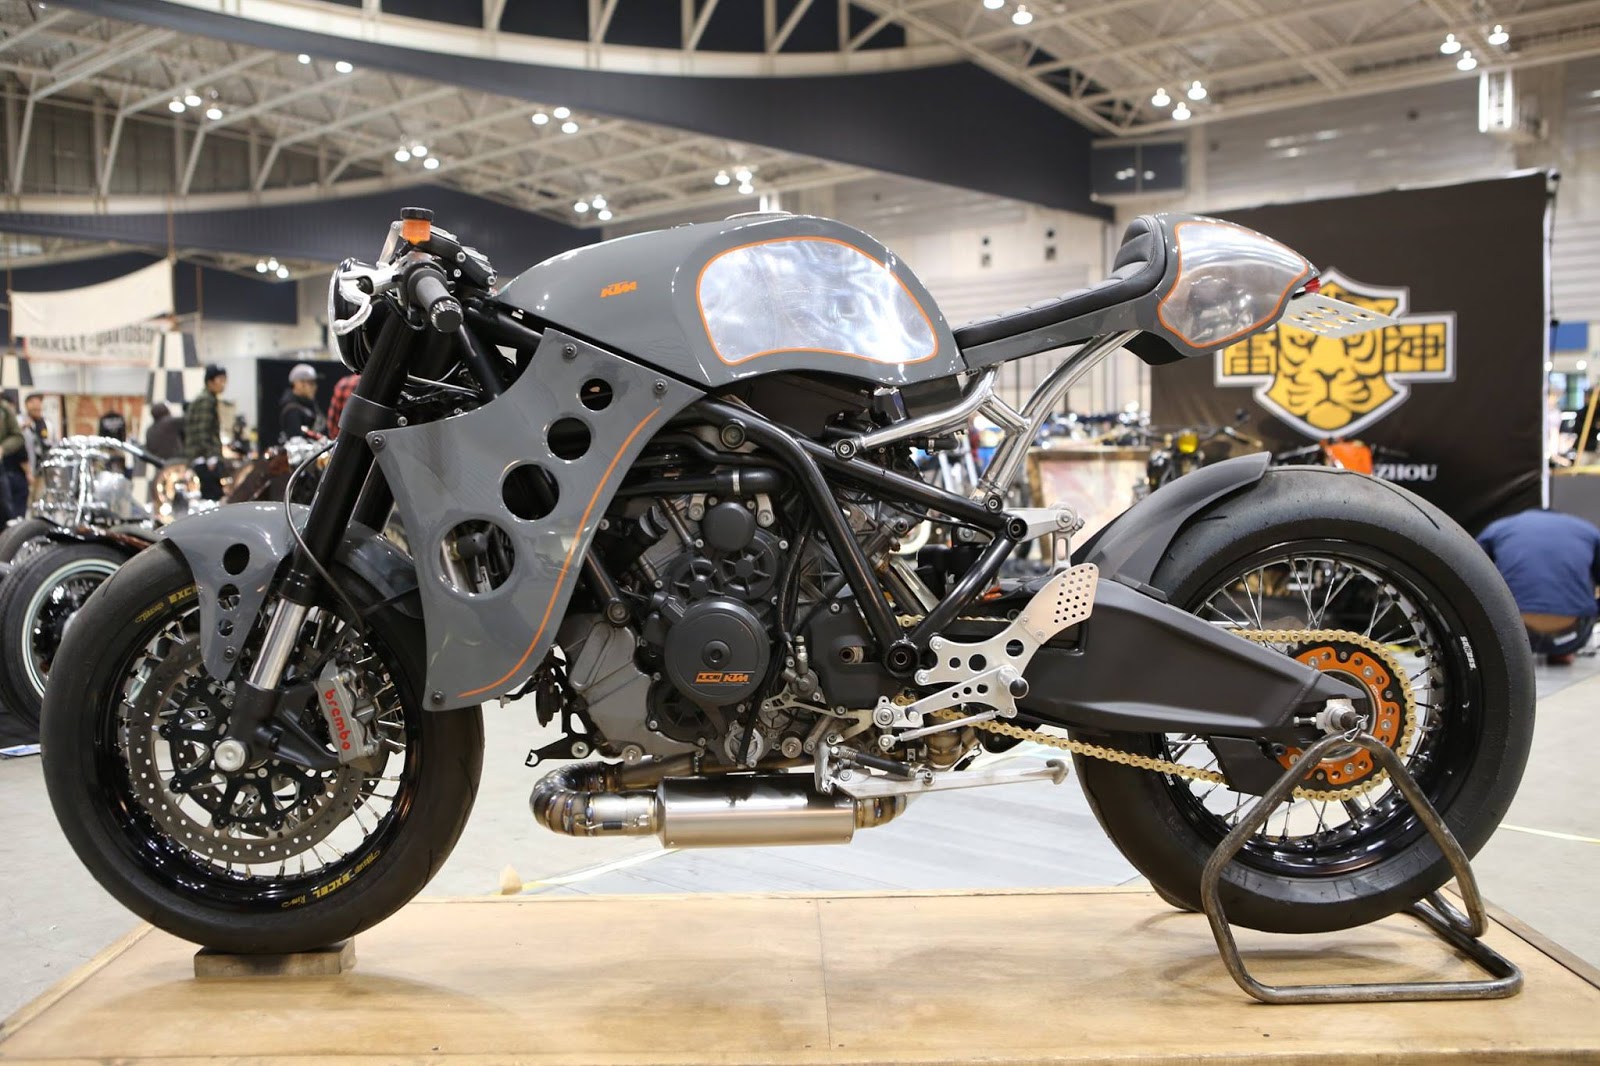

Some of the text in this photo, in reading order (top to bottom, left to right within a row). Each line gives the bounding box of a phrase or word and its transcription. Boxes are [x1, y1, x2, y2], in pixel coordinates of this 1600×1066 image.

[599, 280, 638, 298] KTM
[324, 688, 352, 751] brembo
[312, 872, 351, 899] EXCEL
